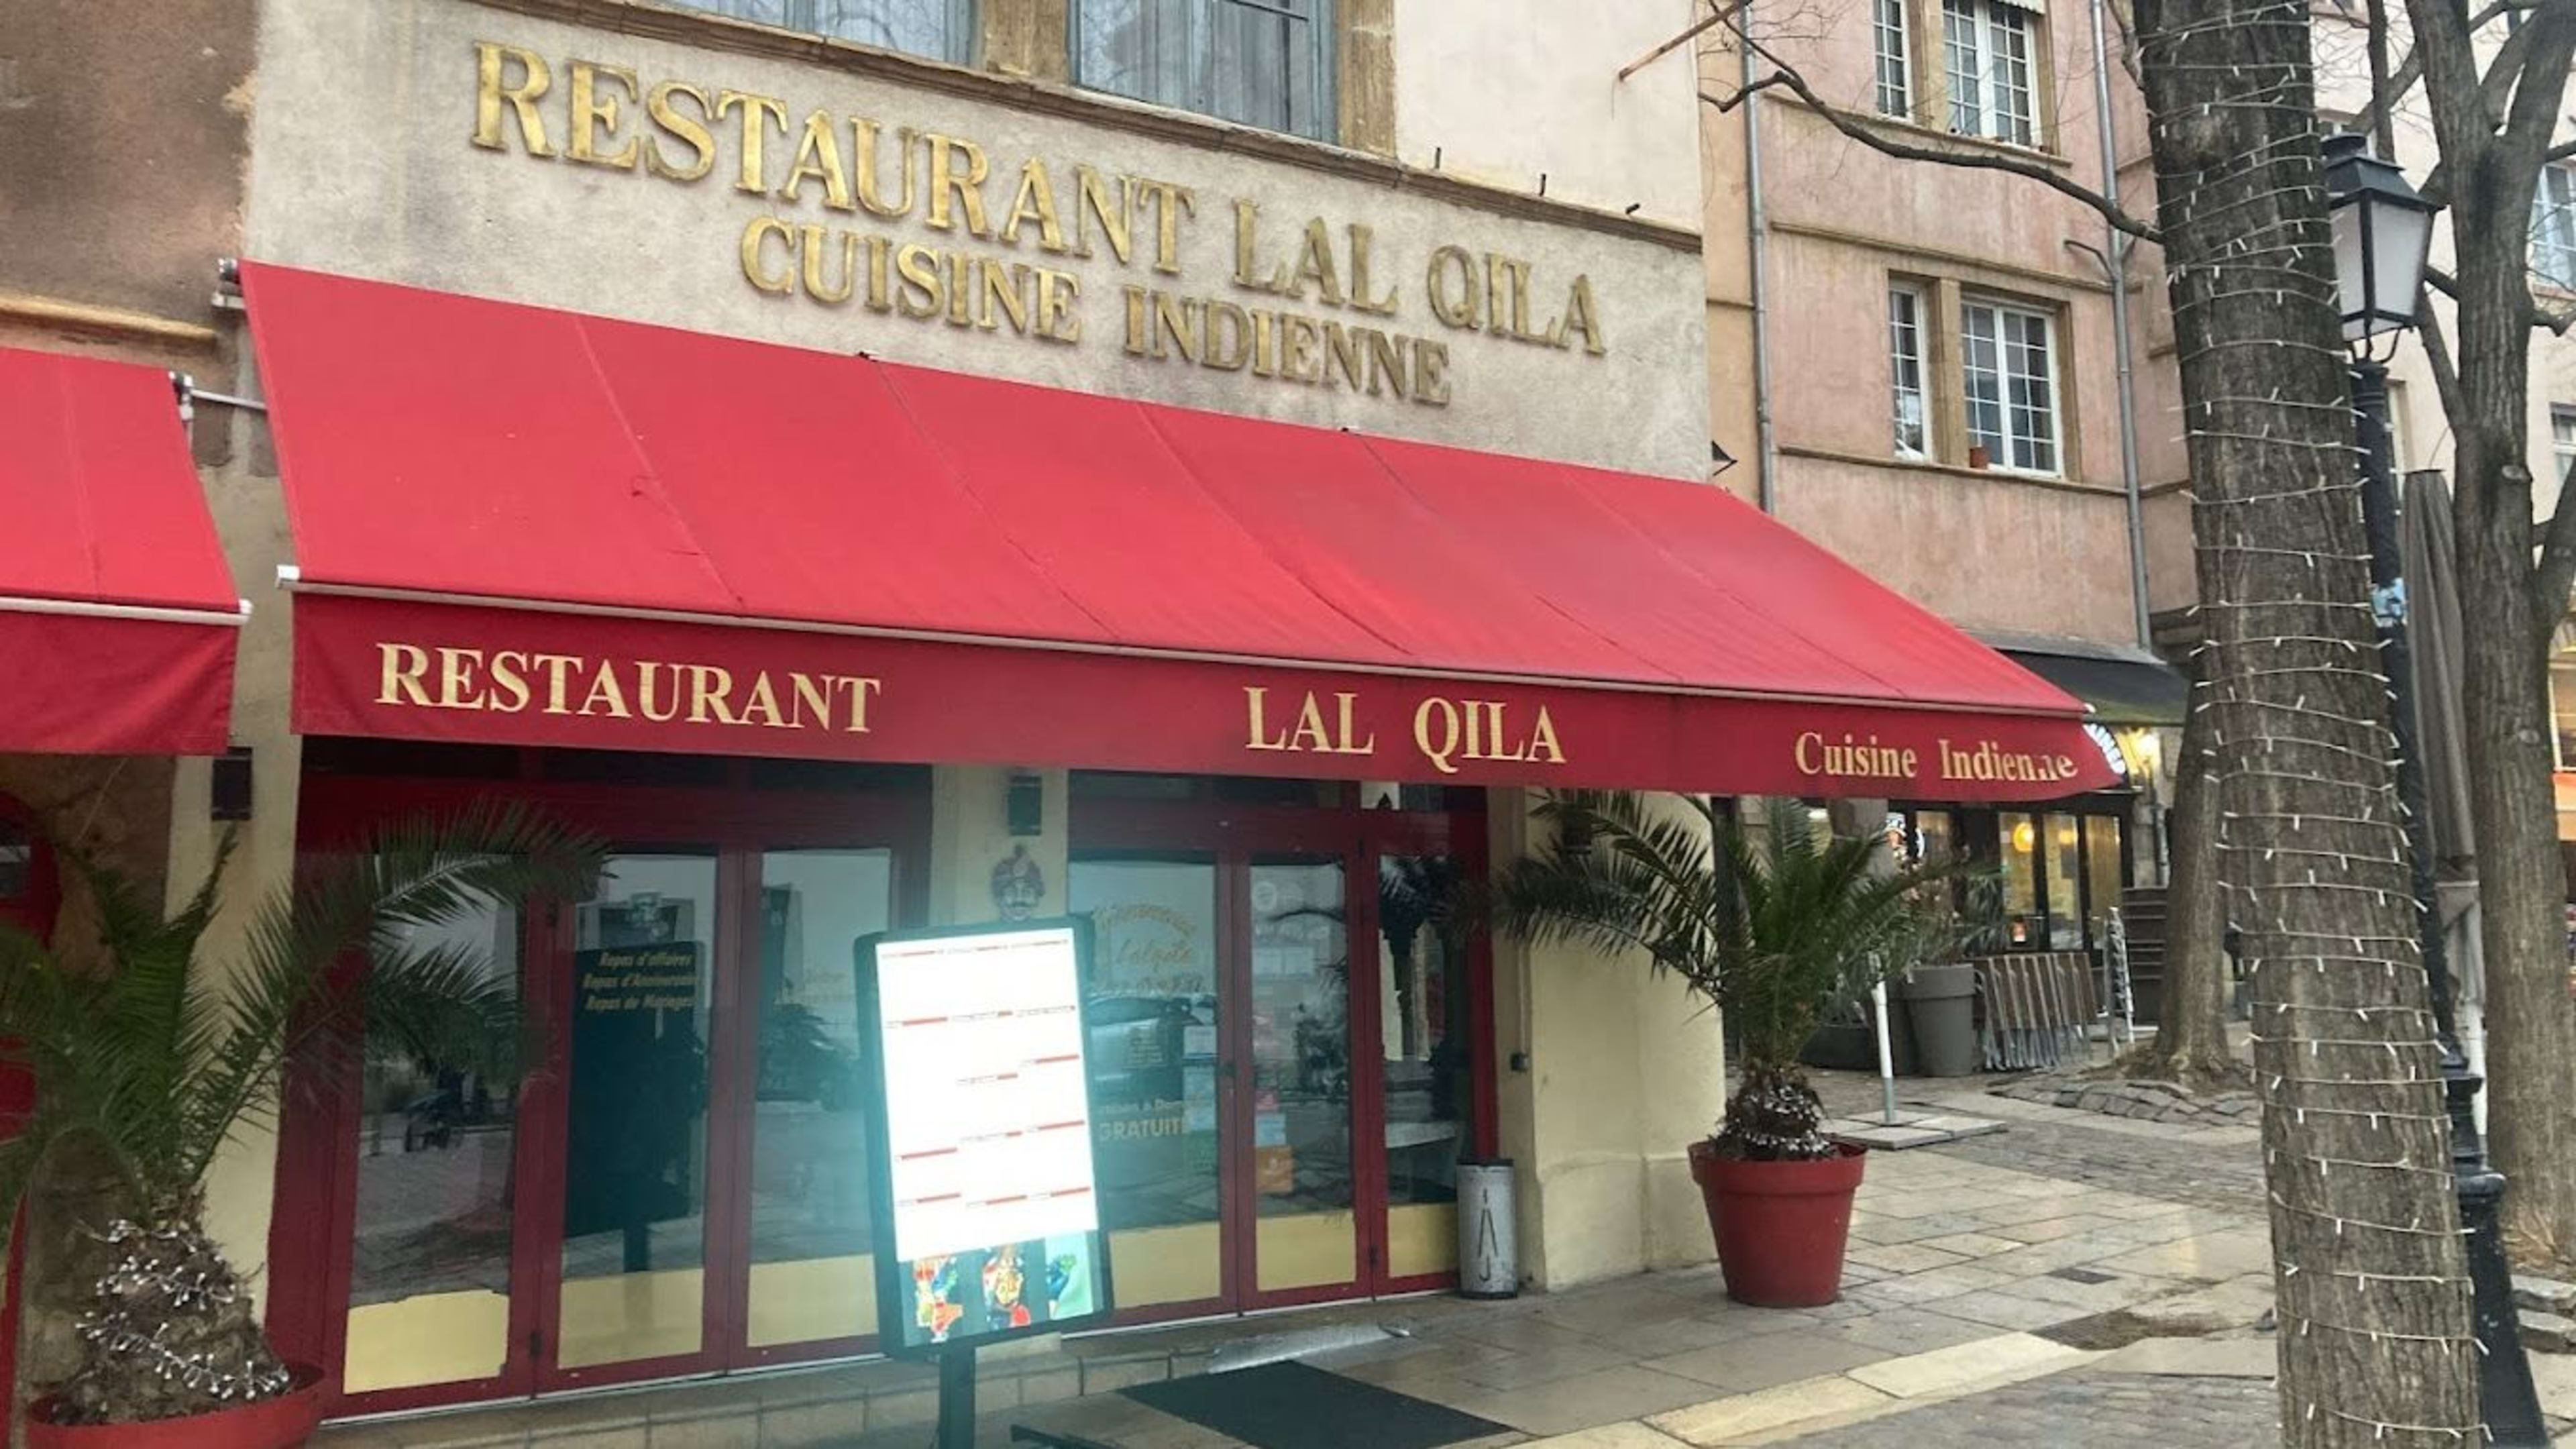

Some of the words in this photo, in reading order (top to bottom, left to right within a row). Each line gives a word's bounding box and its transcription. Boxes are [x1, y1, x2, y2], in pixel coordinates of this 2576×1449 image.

[471, 40, 1196, 274] RESTAURANT
[1233, 196, 1400, 316] LAL
[1426, 244, 1607, 356] QILA
[740, 216, 1083, 345] CUISINE
[1123, 283, 1452, 406] INDIENNE
[374, 642, 881, 734] RESTAURANT
[1242, 686, 1375, 755] LAL
[1413, 696, 1567, 773] QILA
[1794, 731, 1919, 778] Cuisine
